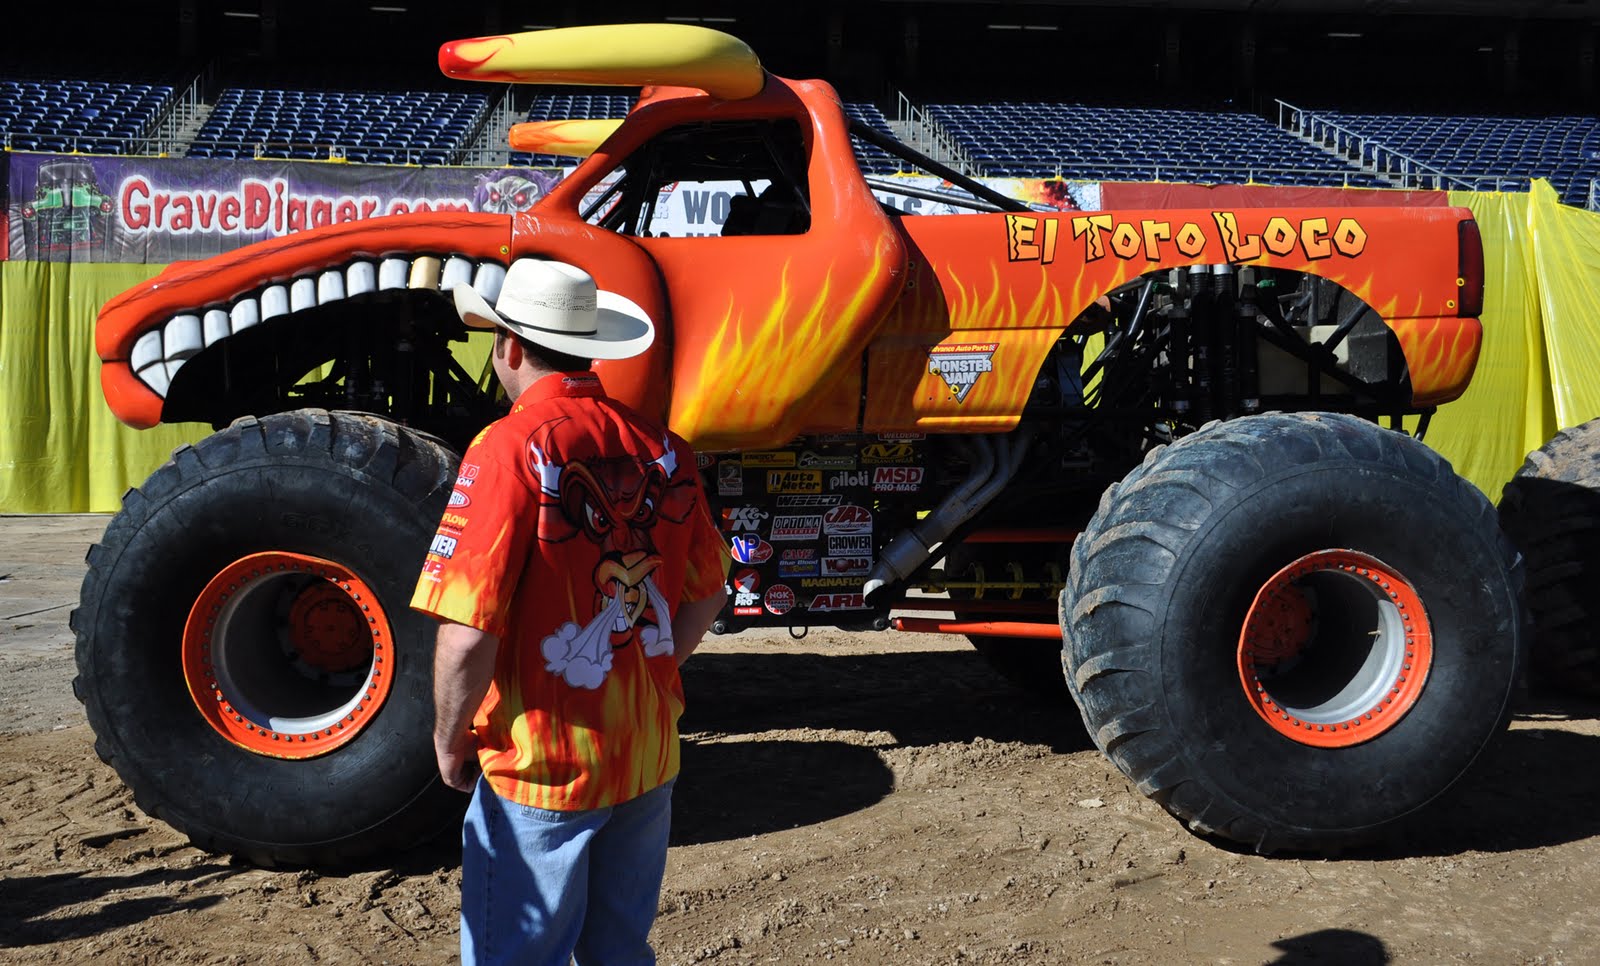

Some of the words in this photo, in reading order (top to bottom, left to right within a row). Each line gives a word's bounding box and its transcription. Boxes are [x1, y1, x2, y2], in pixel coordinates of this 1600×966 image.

[119, 177, 470, 233] GraveDigger
[1071, 214, 1208, 262] Toro
[1212, 211, 1369, 264] Loco
[929, 360, 992, 374] MONSTER
[943, 372, 977, 384] JAM
[784, 472, 815, 482] Auto
[829, 471, 869, 490] piloti
[875, 468, 921, 483] MSD
[781, 481, 820, 491] Meter
[824, 506, 872, 523] JAZ
[774, 517, 820, 529] OPTIMA
[731, 533, 760, 564] VP
[829, 536, 871, 549] CROWER
[801, 578, 865, 588] MAGNAFLO
[769, 591, 790, 600] NGK
